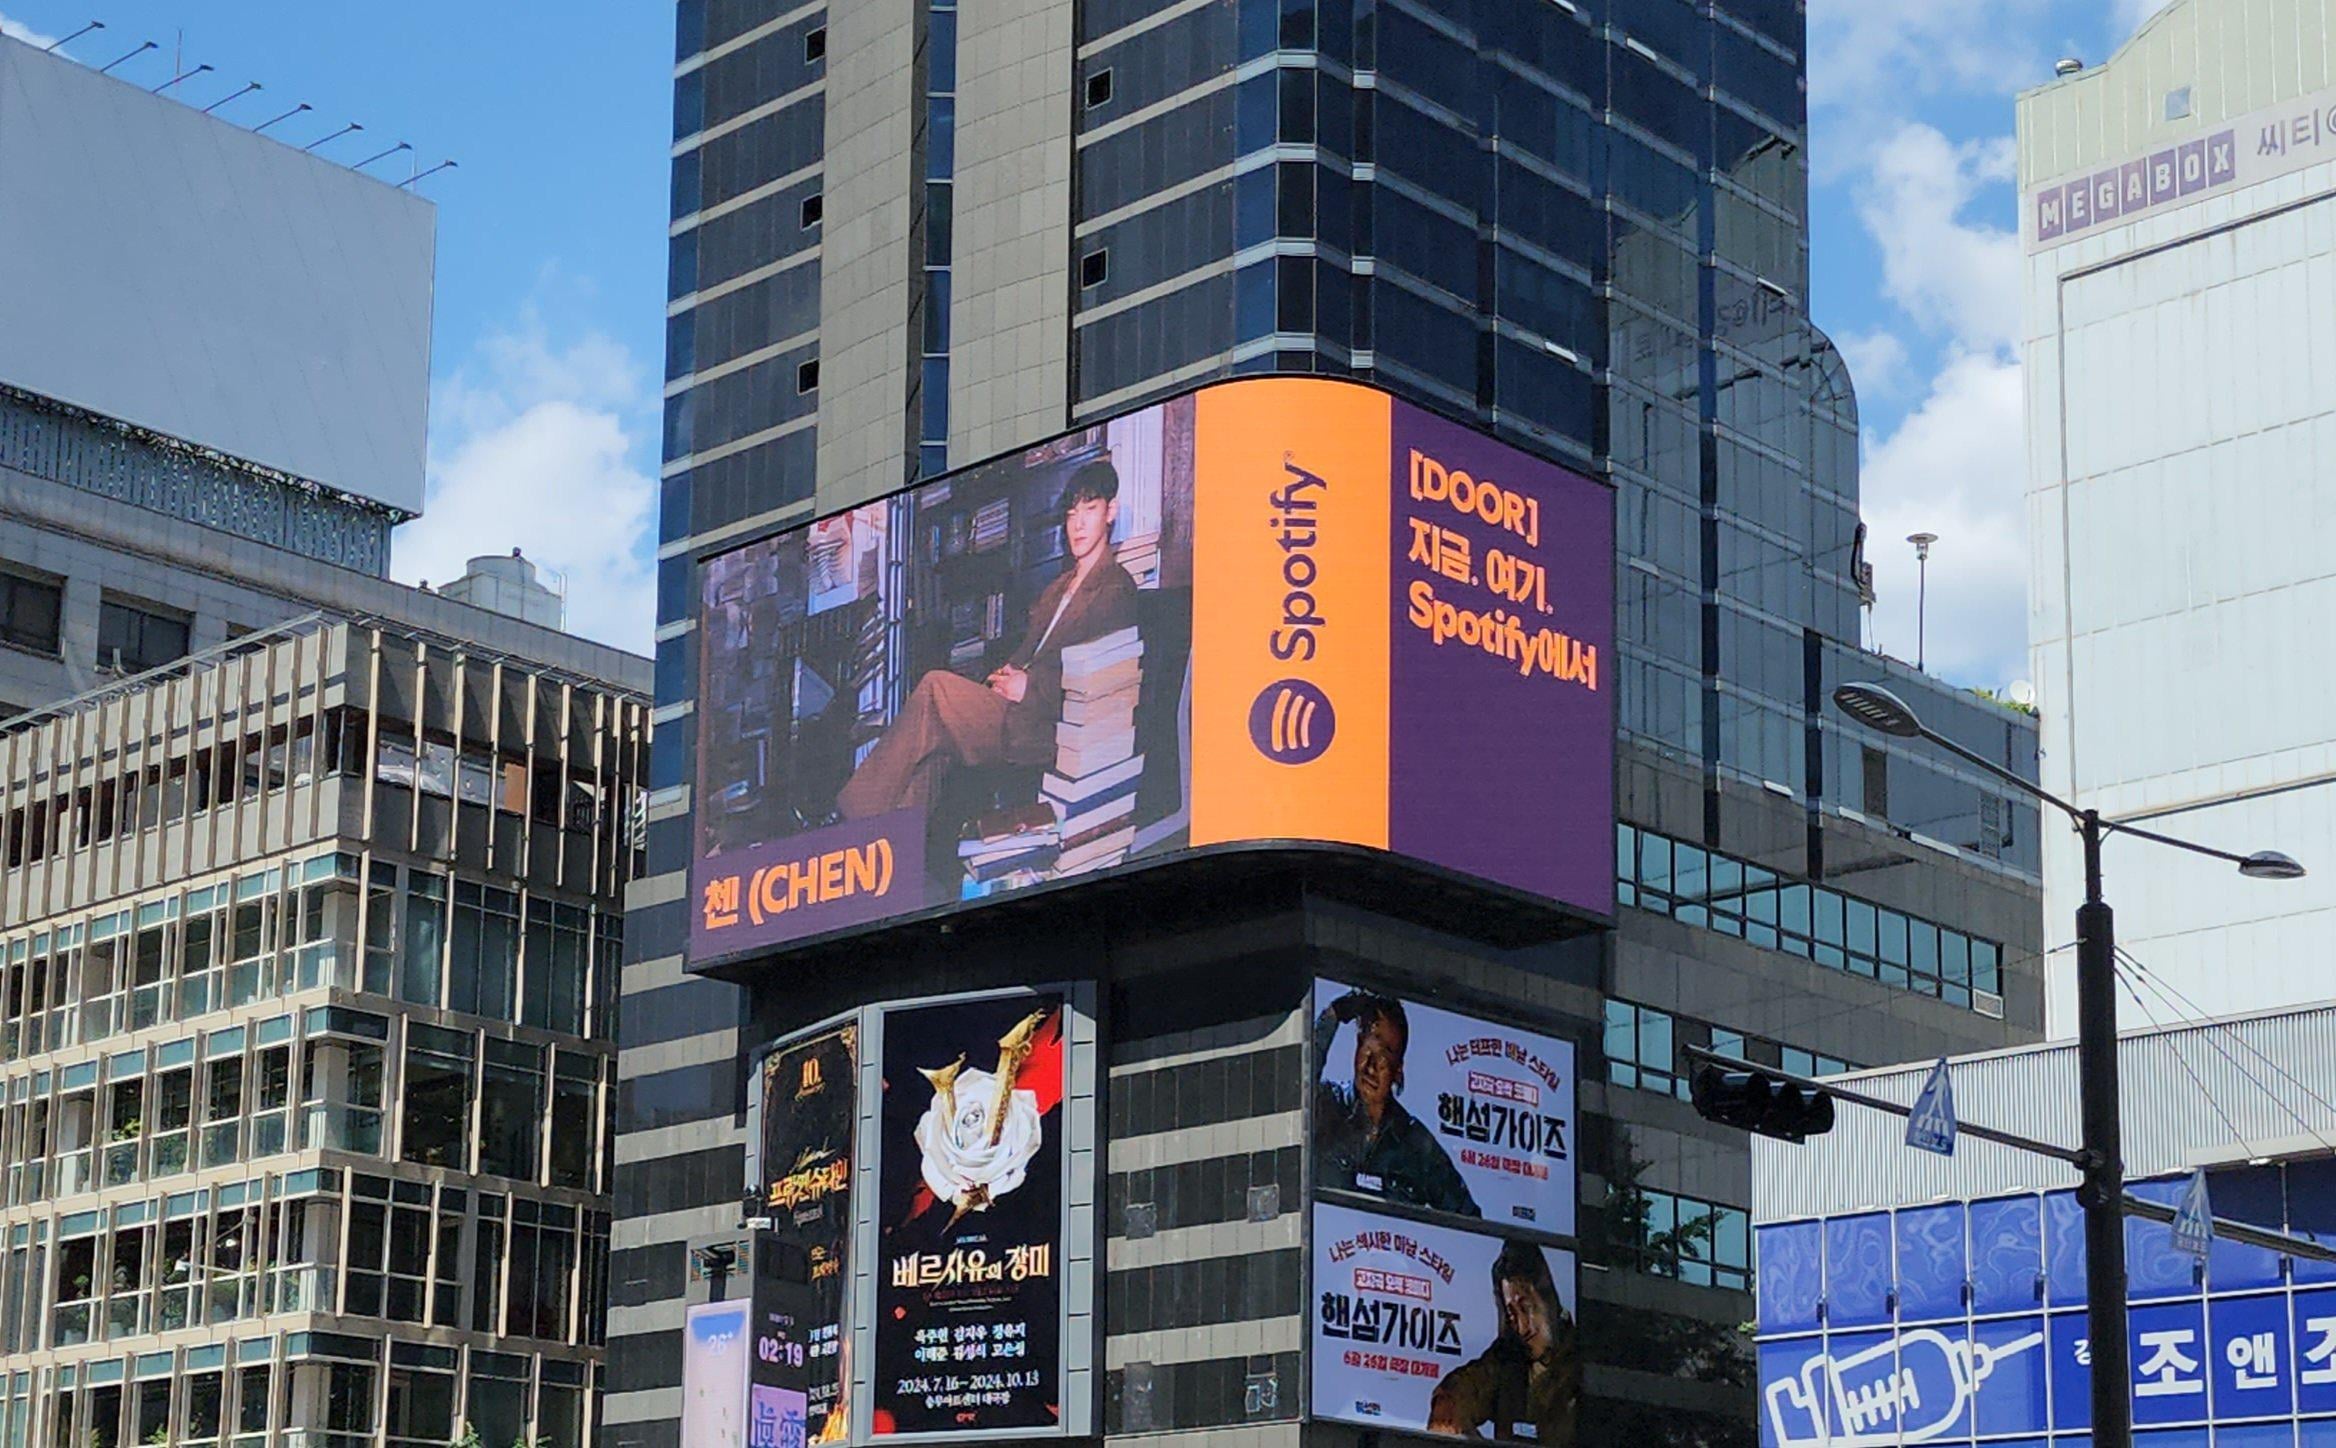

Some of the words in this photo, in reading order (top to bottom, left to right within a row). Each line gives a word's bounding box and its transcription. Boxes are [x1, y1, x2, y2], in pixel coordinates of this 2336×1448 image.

[2041, 143, 2229, 230] MEGABOX
[1409, 448, 1538, 547] [DOOR]
[1408, 517, 1479, 586] 지금.
[1486, 549, 1554, 615] 여기.
[1409, 580, 1597, 691] Spotify에서
[703, 876, 740, 930] 첸
[748, 838, 894, 926] (CHEN)
[1438, 1092, 1567, 1160] 핸섬가이즈
[892, 1248, 1003, 1292] 베르사유의
[1004, 1242, 1050, 1281] 장미
[1329, 1239, 1356, 1263] 나는
[758, 1336, 803, 1367] 02:19
[1321, 1292, 1462, 1356] 핸섬가이즈
